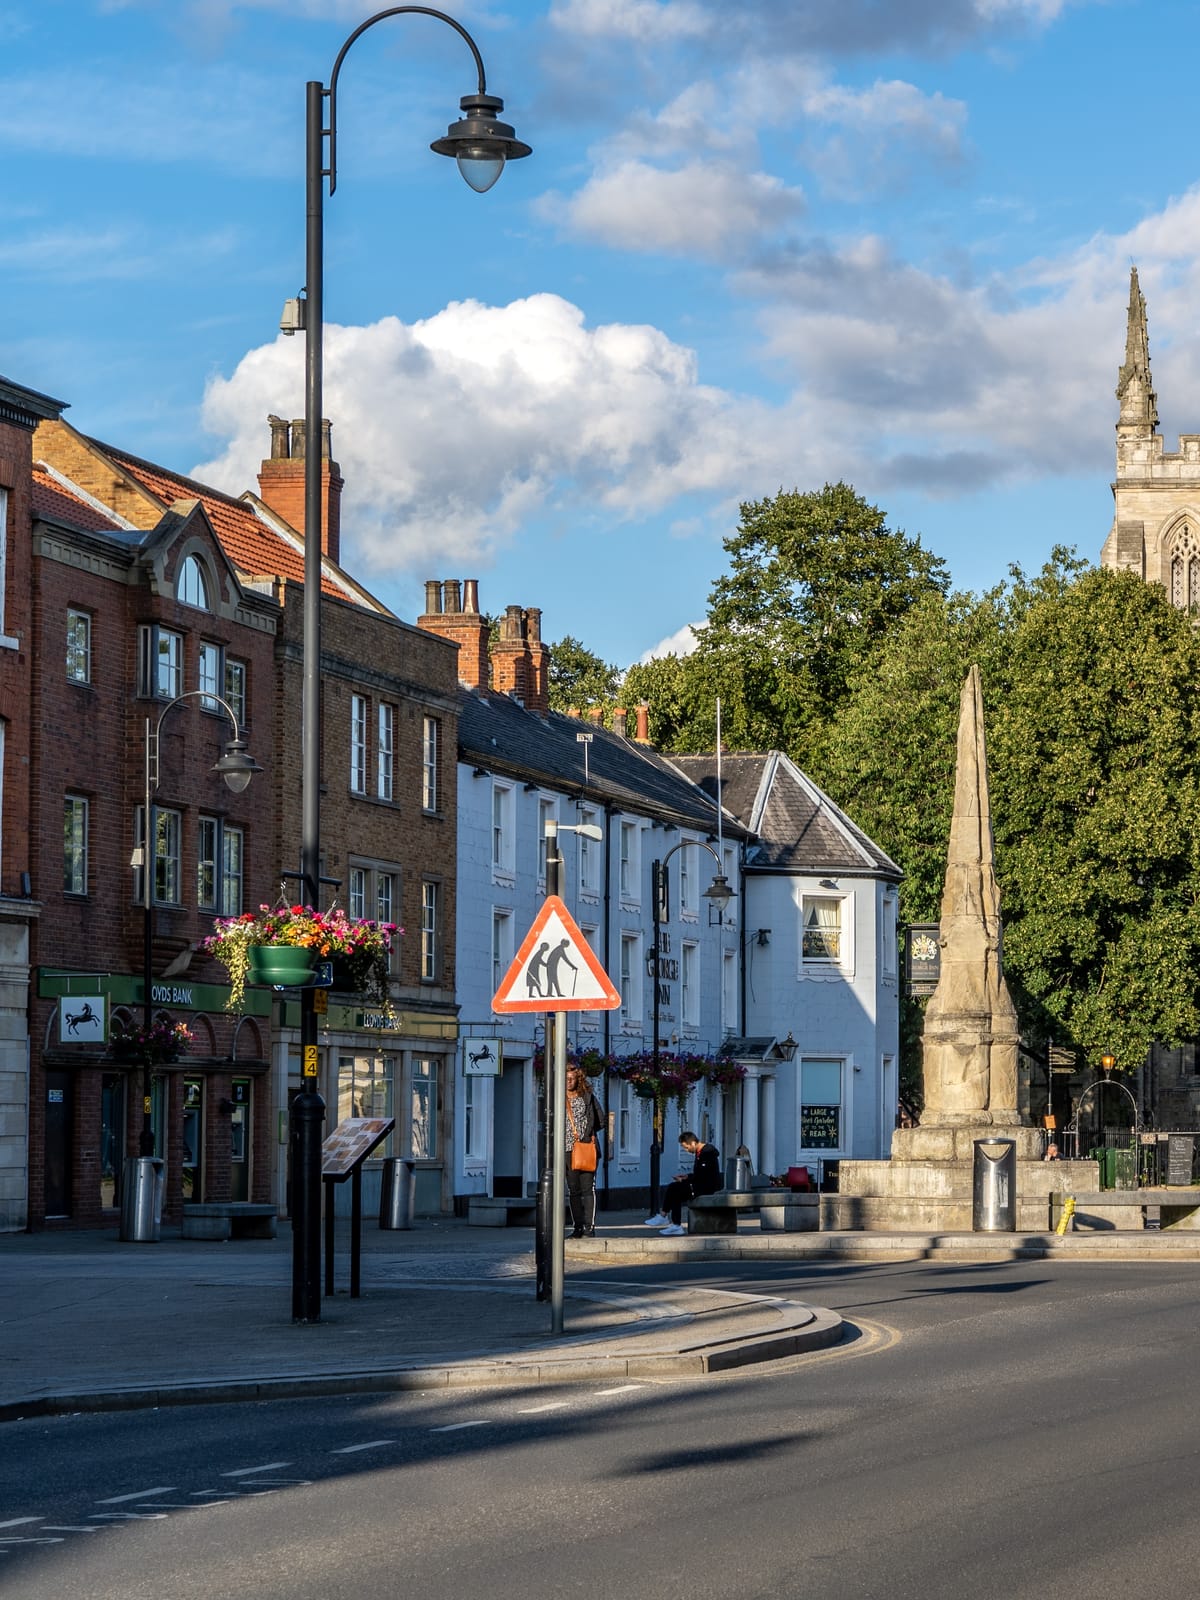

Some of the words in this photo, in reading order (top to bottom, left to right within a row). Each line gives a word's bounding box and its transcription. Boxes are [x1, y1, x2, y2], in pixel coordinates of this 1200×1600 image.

[647, 957, 680, 981] GORGE
[151, 986, 172, 1003] OYDS
[173, 988, 192, 1005] BANK
